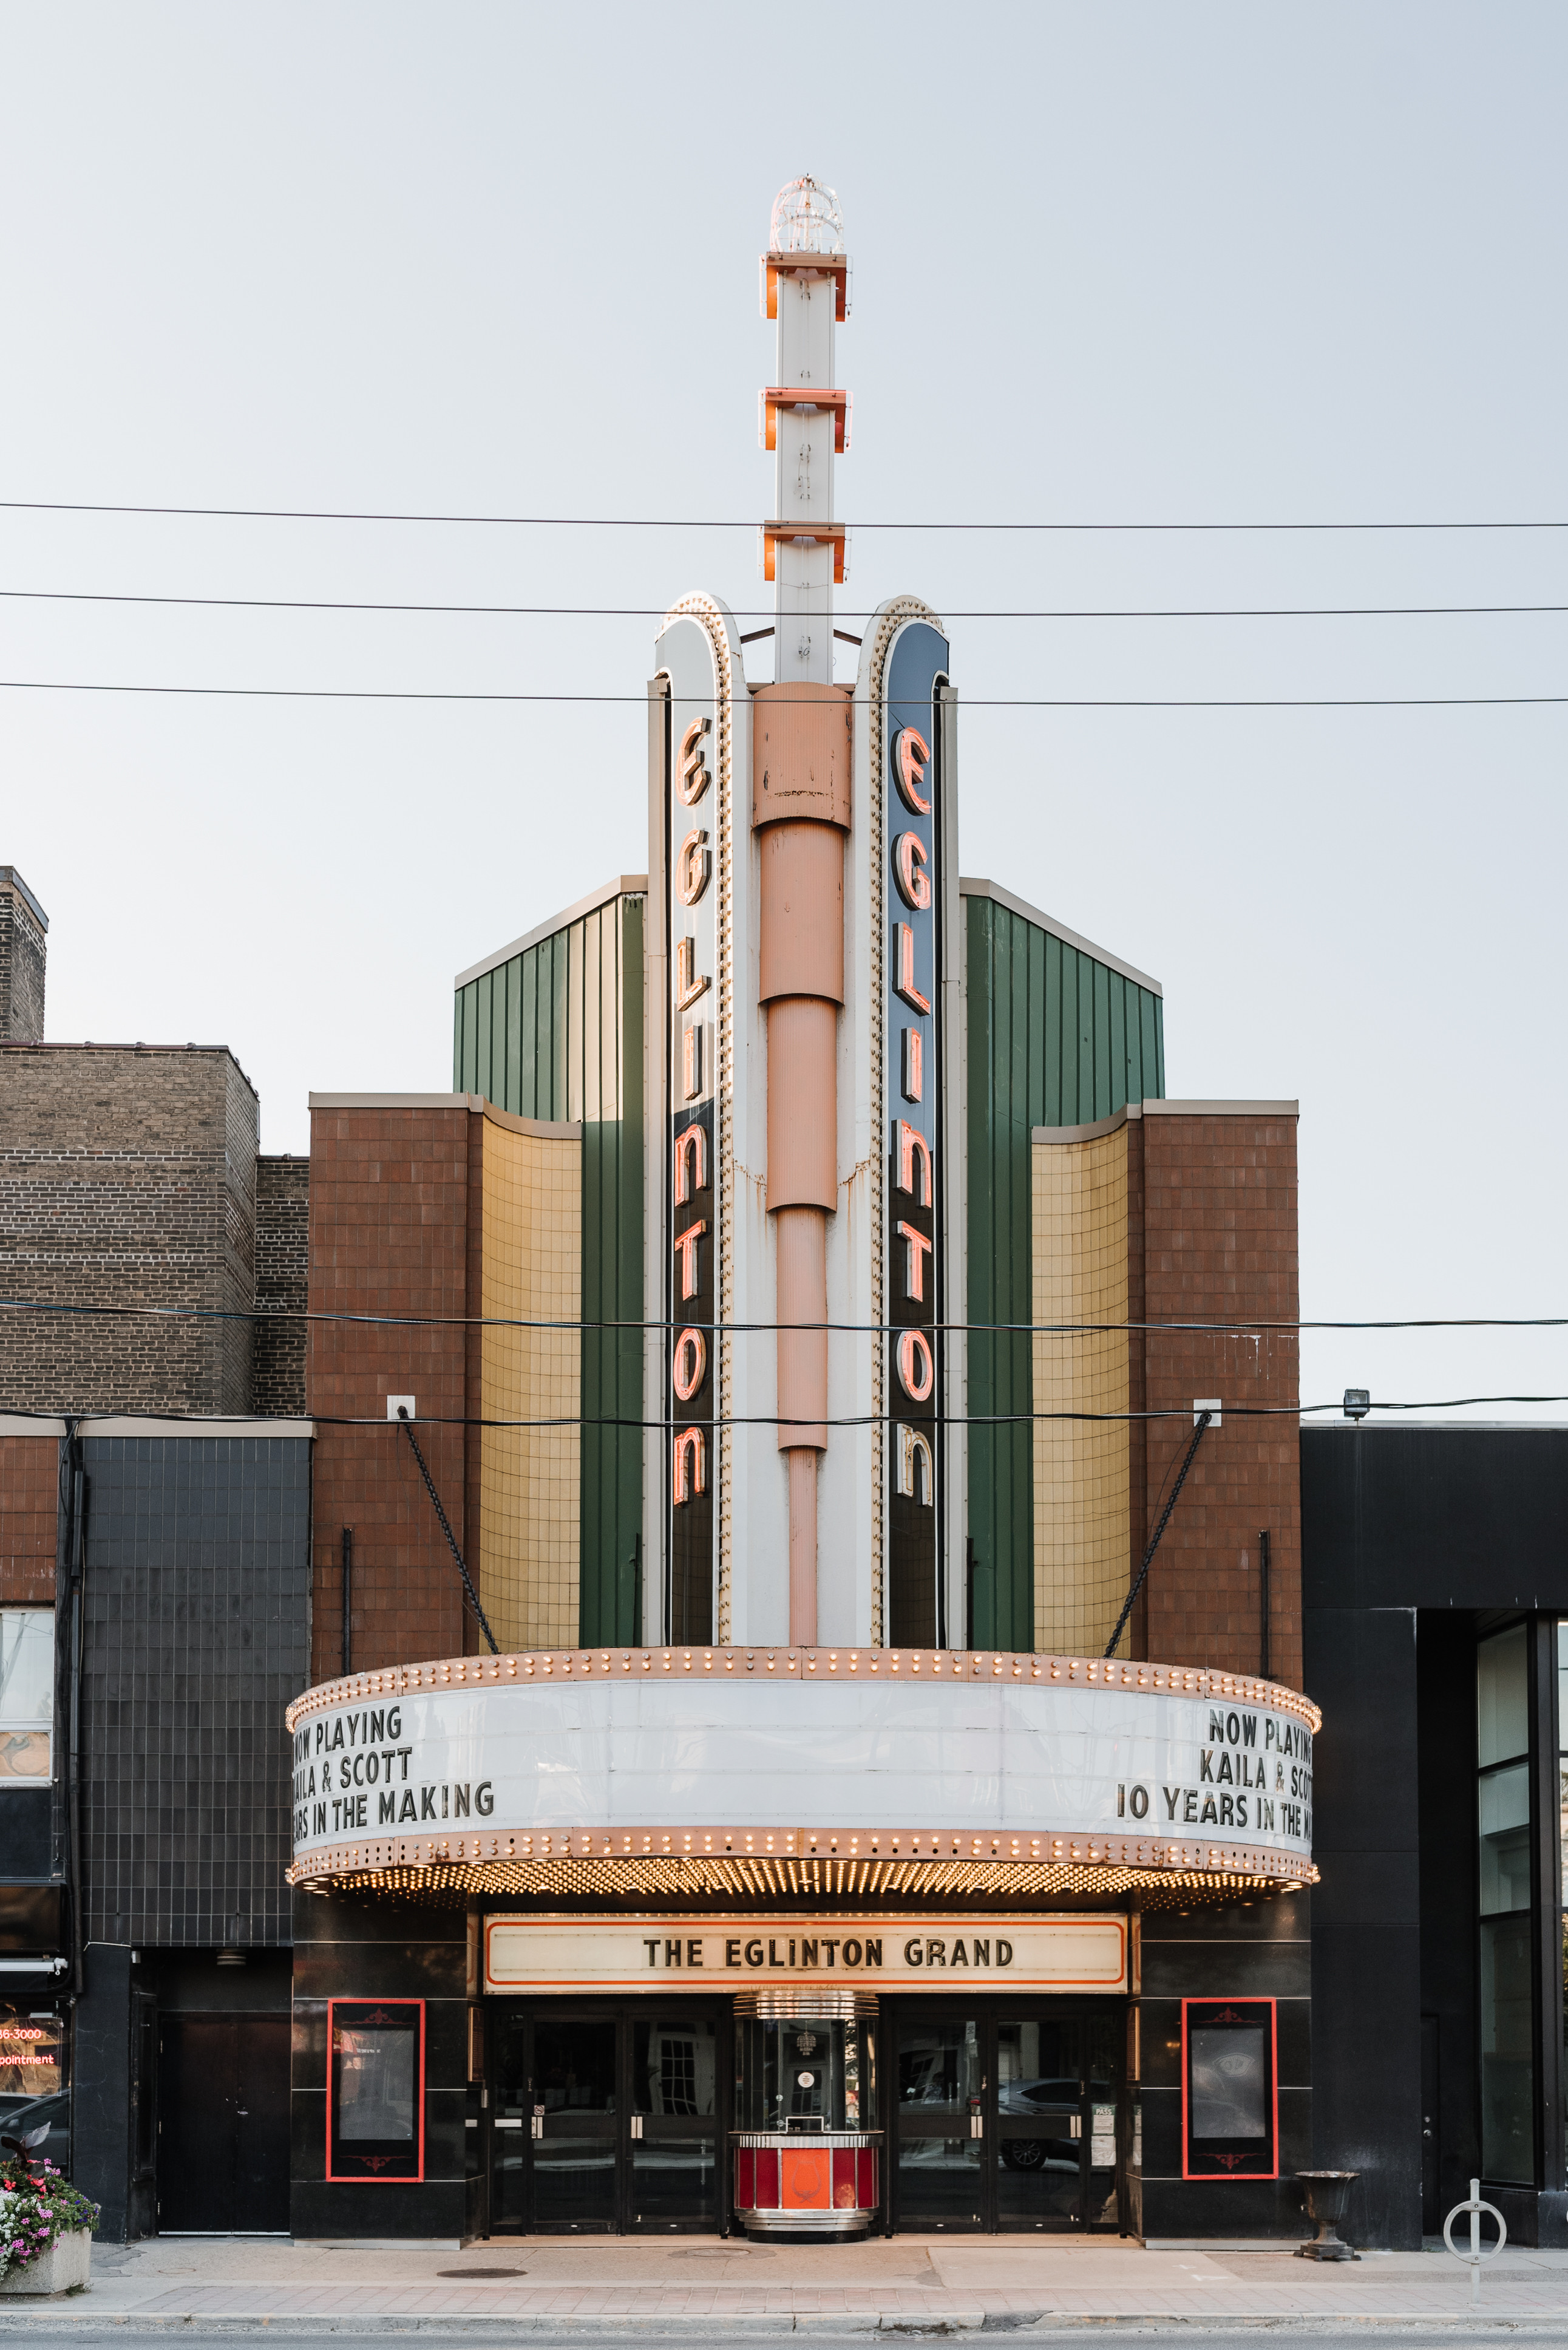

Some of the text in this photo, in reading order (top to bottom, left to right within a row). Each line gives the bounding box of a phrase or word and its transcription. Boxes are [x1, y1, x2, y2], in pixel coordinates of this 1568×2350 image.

[295, 1706, 402, 1766] NOW PLAYING
[1209, 1709, 1311, 1765] NOW PLAYING
[322, 1760, 331, 1793] &
[340, 1746, 413, 1789] SCOTT
[1200, 1749, 1266, 1790] KAILA
[1275, 1761, 1285, 1794] &
[313, 1801, 326, 1835] IN
[332, 1794, 368, 1831] THE
[379, 1781, 494, 1824] MAKING
[1162, 1786, 1248, 1827] YEARS
[1257, 1797, 1274, 1831] IN
[1280, 1802, 1301, 1837] THE
[643, 1938, 1014, 1967] THE EGLINTON GRAND
